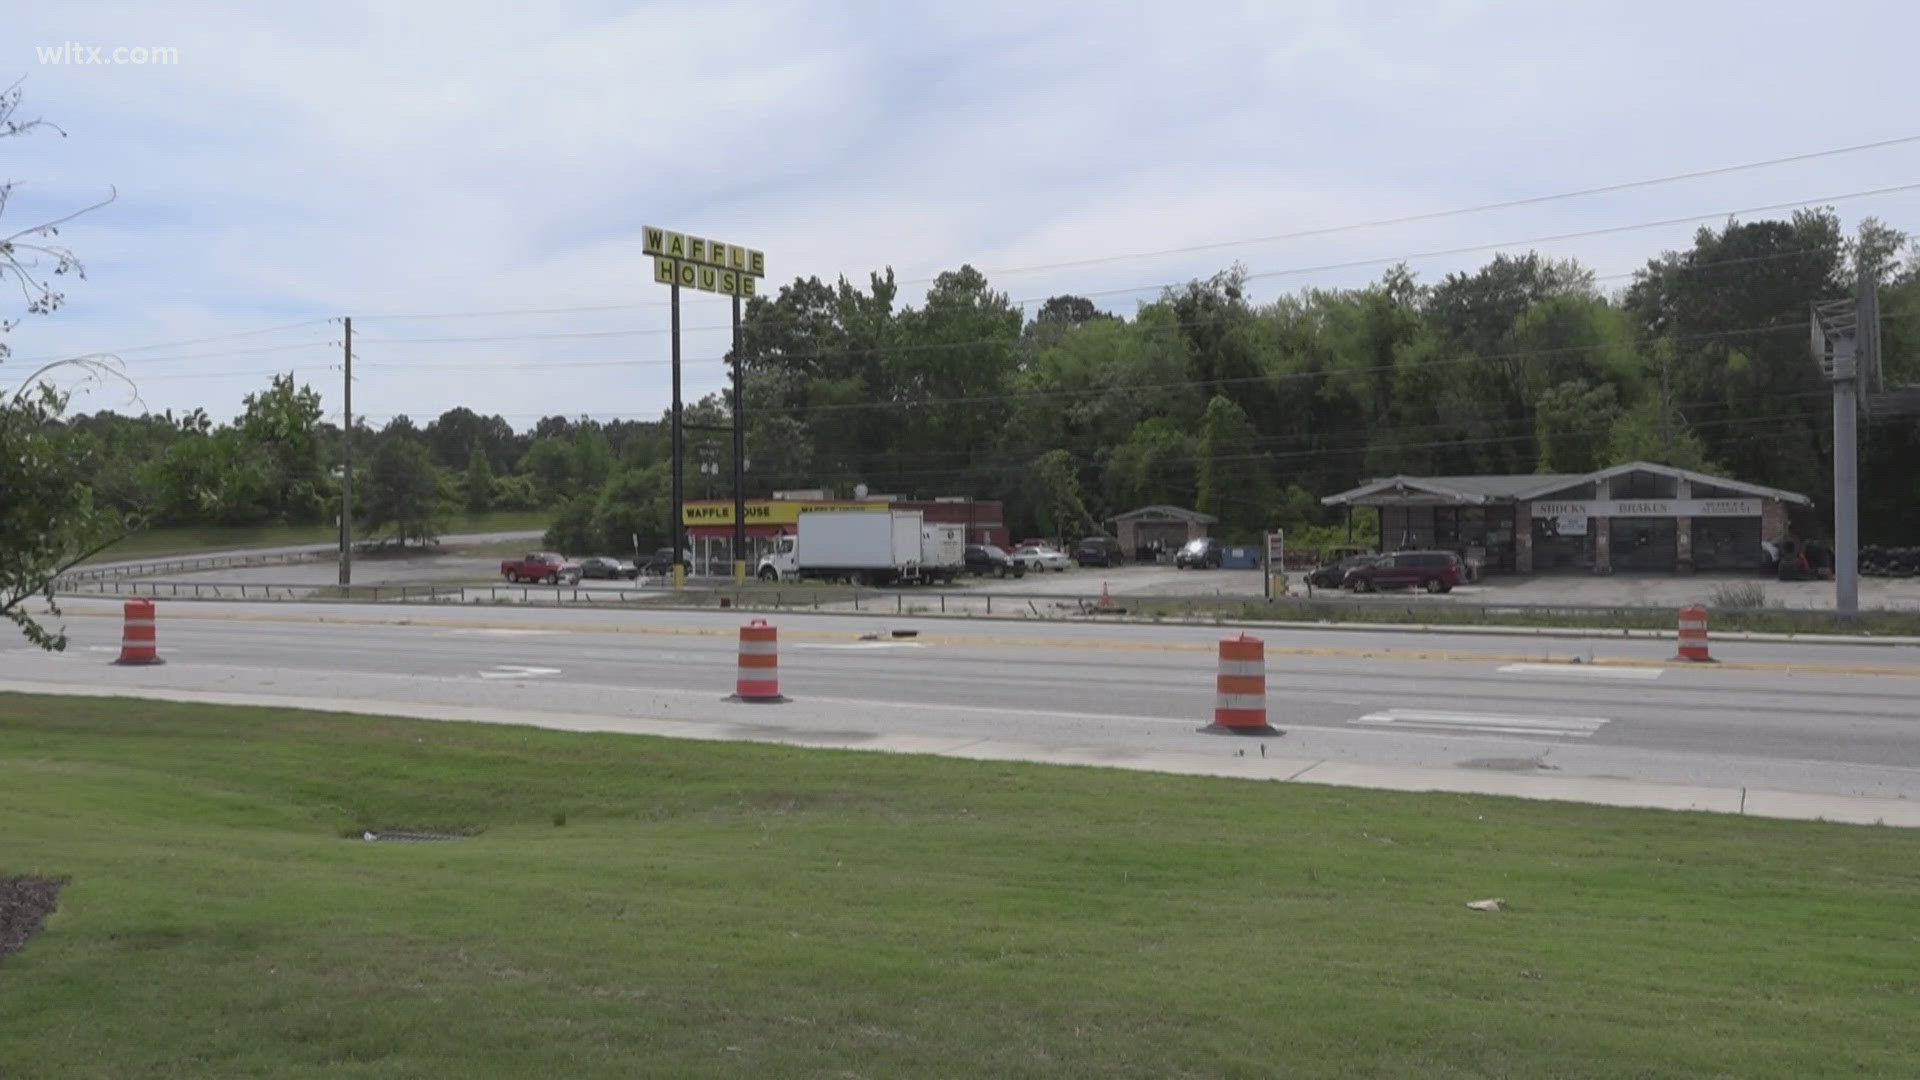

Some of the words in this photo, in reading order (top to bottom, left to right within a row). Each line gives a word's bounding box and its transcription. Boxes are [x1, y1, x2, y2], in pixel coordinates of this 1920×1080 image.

[648, 230, 763, 271] WAFFLE
[661, 261, 754, 295] HOUSE
[686, 507, 729, 518] WAFFLE
[1540, 503, 1586, 514] SHOCKS
